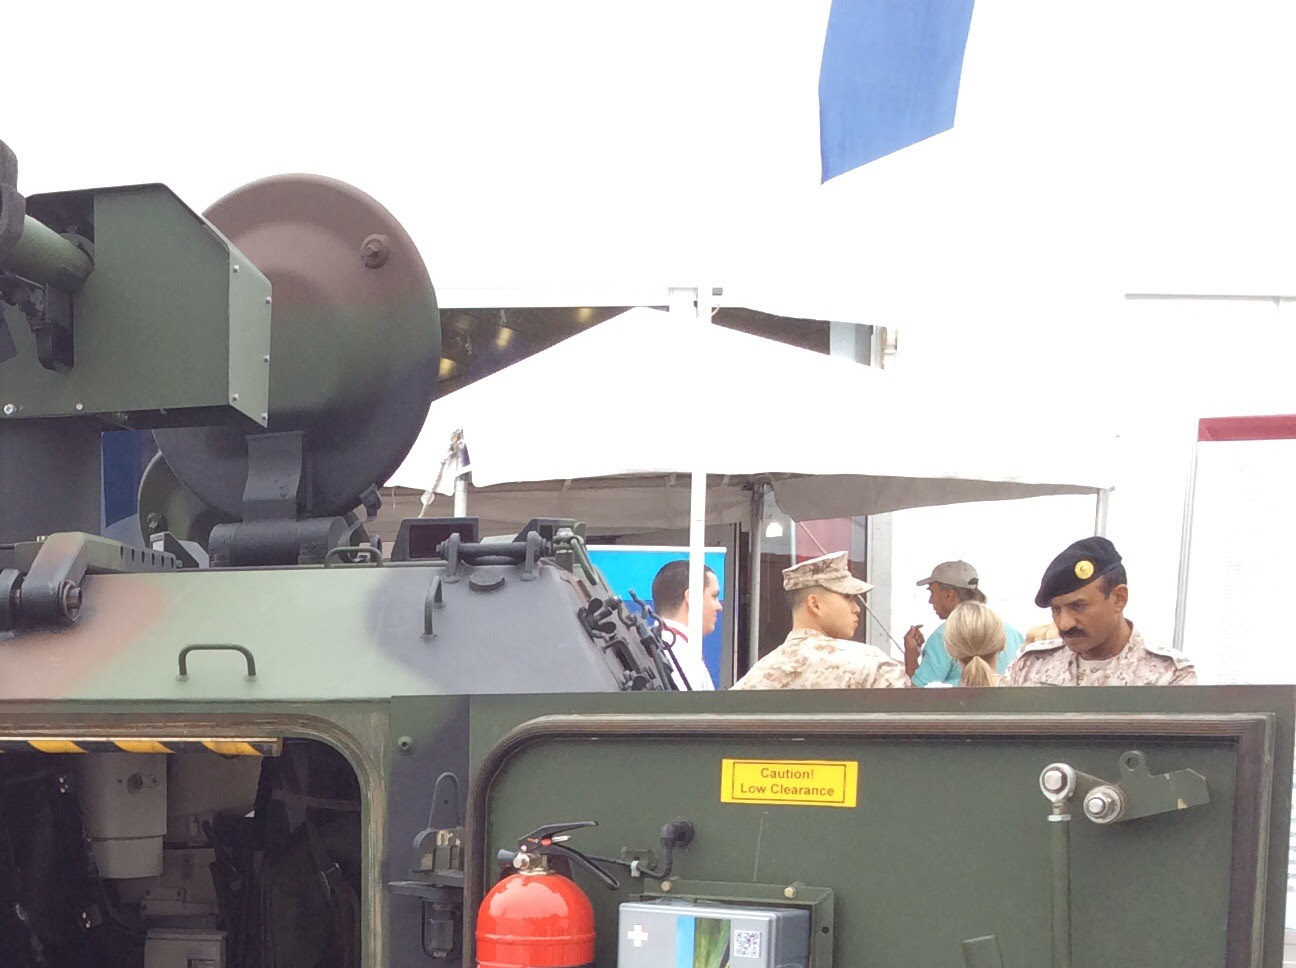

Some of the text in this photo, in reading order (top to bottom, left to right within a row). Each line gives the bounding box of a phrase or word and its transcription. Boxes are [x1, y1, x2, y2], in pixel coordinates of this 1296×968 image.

[760, 767, 814, 780] Caution!
[740, 782, 835, 796] Low Clearance
